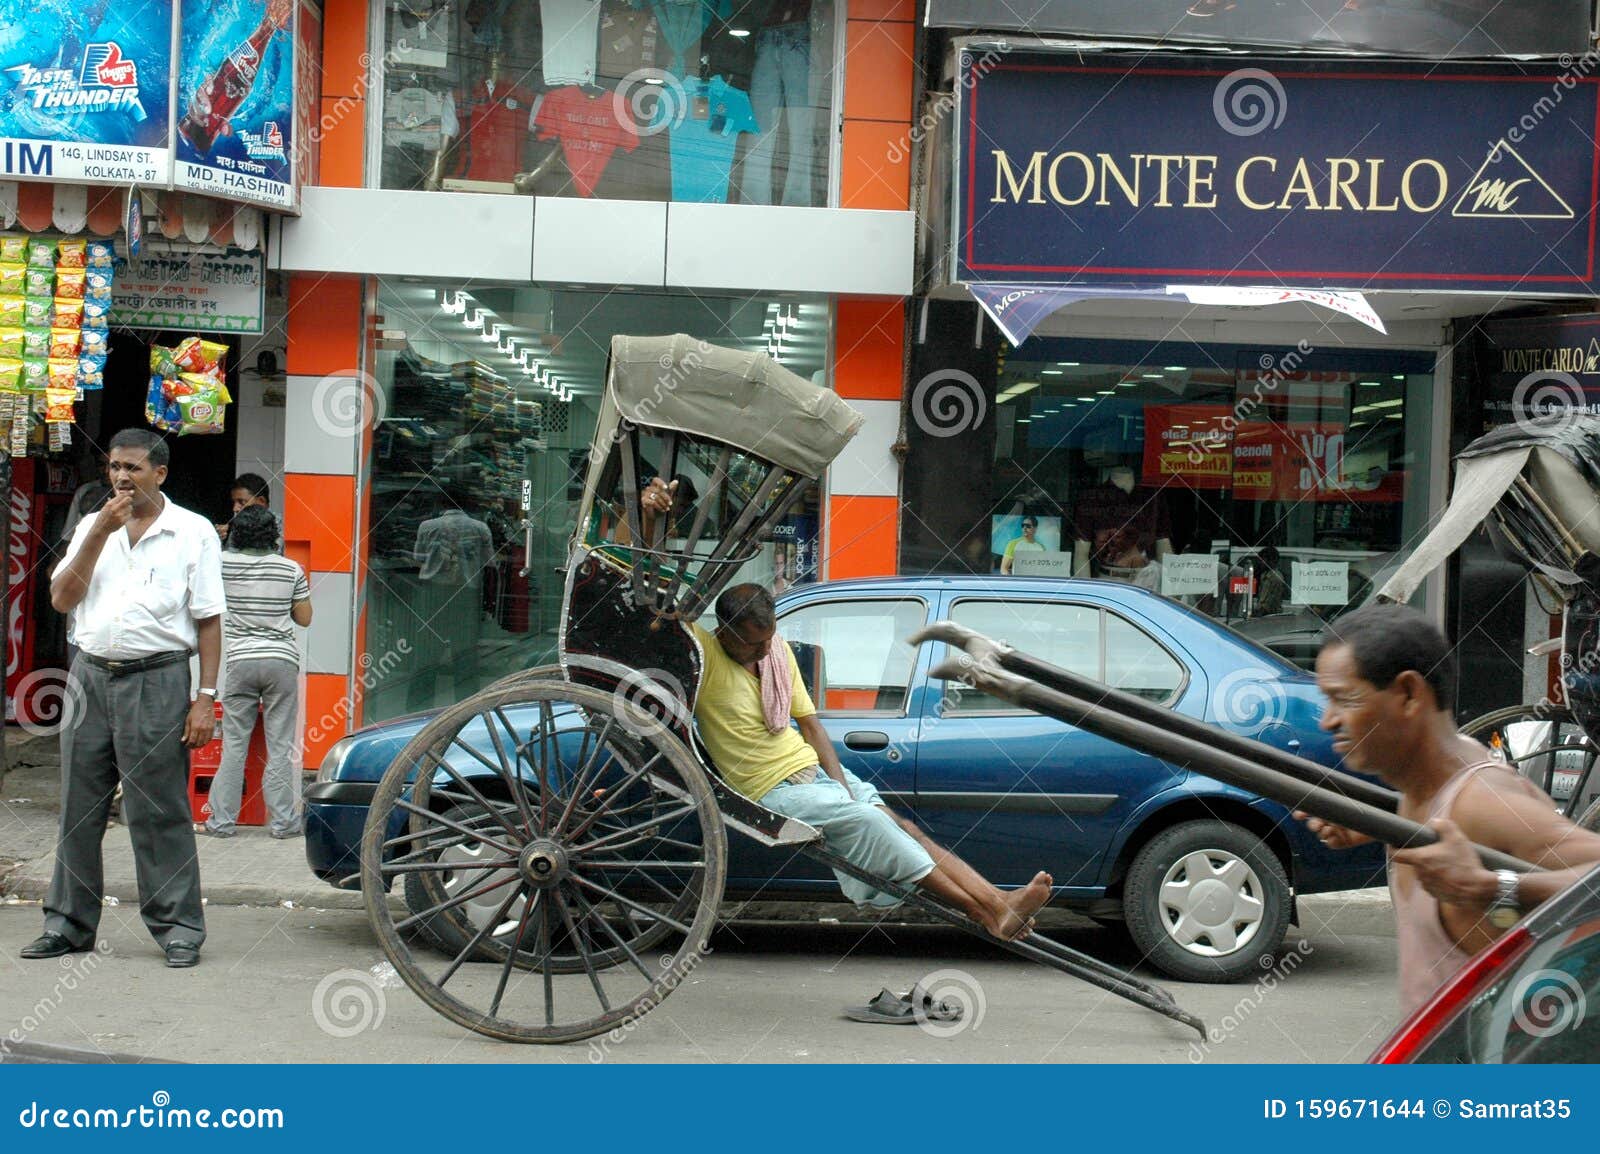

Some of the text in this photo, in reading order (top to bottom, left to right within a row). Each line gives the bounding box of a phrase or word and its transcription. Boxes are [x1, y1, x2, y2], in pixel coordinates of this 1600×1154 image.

[4, 63, 74, 85] TASTE
[53, 80, 78, 91] THE
[24, 86, 147, 121] THUNDER
[60, 147, 84, 160] 14G,
[87, 149, 134, 163] LINDSAY
[243, 141, 288, 166] THUNDER
[84, 166, 136, 179] KOLKATA
[144, 170, 157, 181] 87
[187, 165, 285, 197] MD. HASHIM
[990, 149, 1218, 209] MONTE
[1235, 156, 1449, 213] CARLO
[1503, 347, 1540, 373] MONTE
[1543, 347, 1584, 373] CARLO
